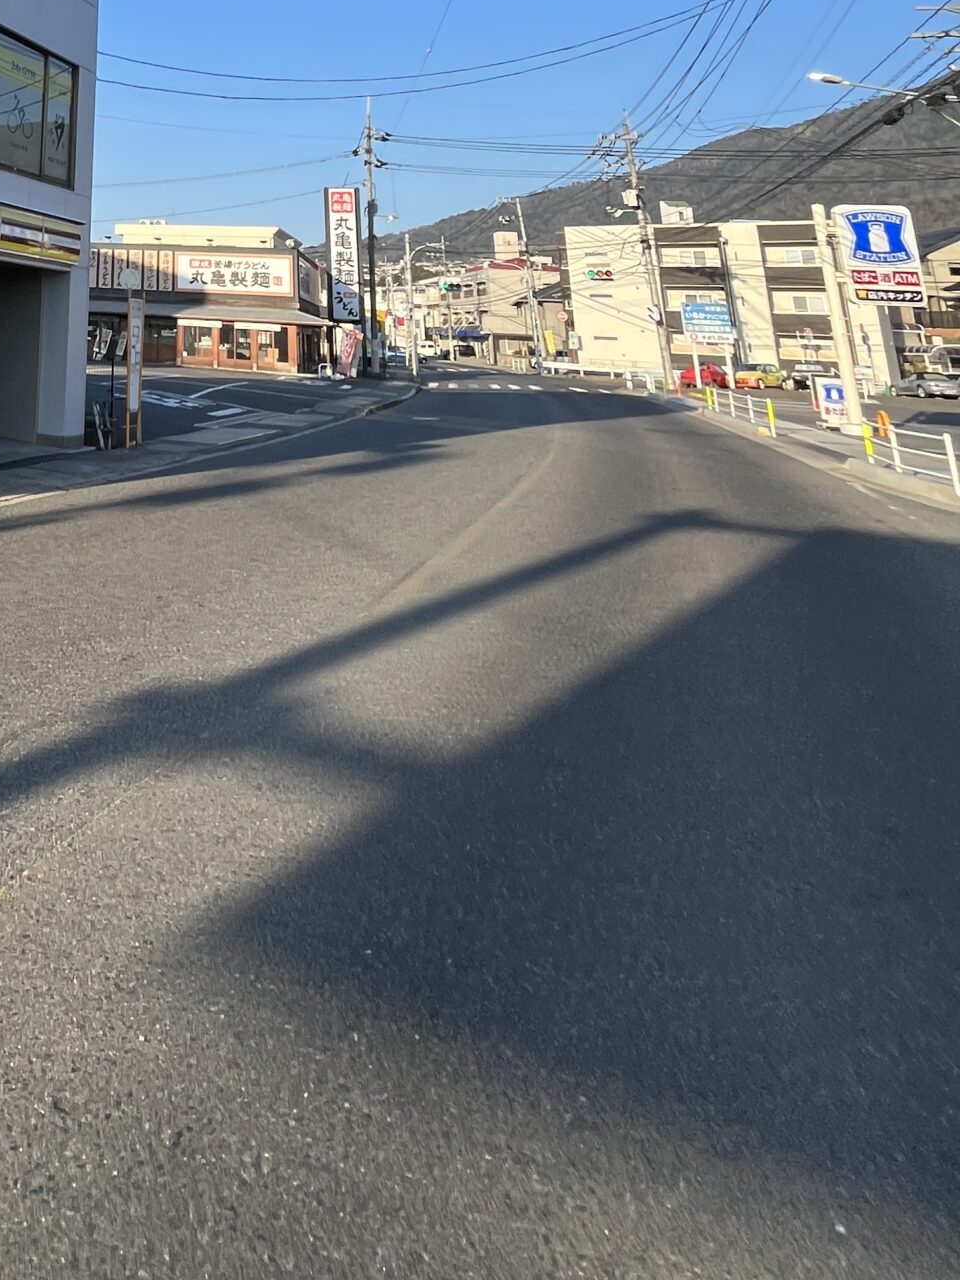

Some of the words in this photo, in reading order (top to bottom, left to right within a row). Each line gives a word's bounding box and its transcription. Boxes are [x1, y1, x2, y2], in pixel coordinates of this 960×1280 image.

[847, 211, 902, 225] LAWSON
[333, 216, 355, 286] 丸亀製麺
[854, 250, 908, 262] STATION
[214, 260, 270, 270] 釜揚げうどん
[189, 269, 271, 288] 丸亀製麺
[852, 271, 878, 283] たばこ
[894, 273, 919, 284] ATM
[333, 292, 358, 318] うどん
